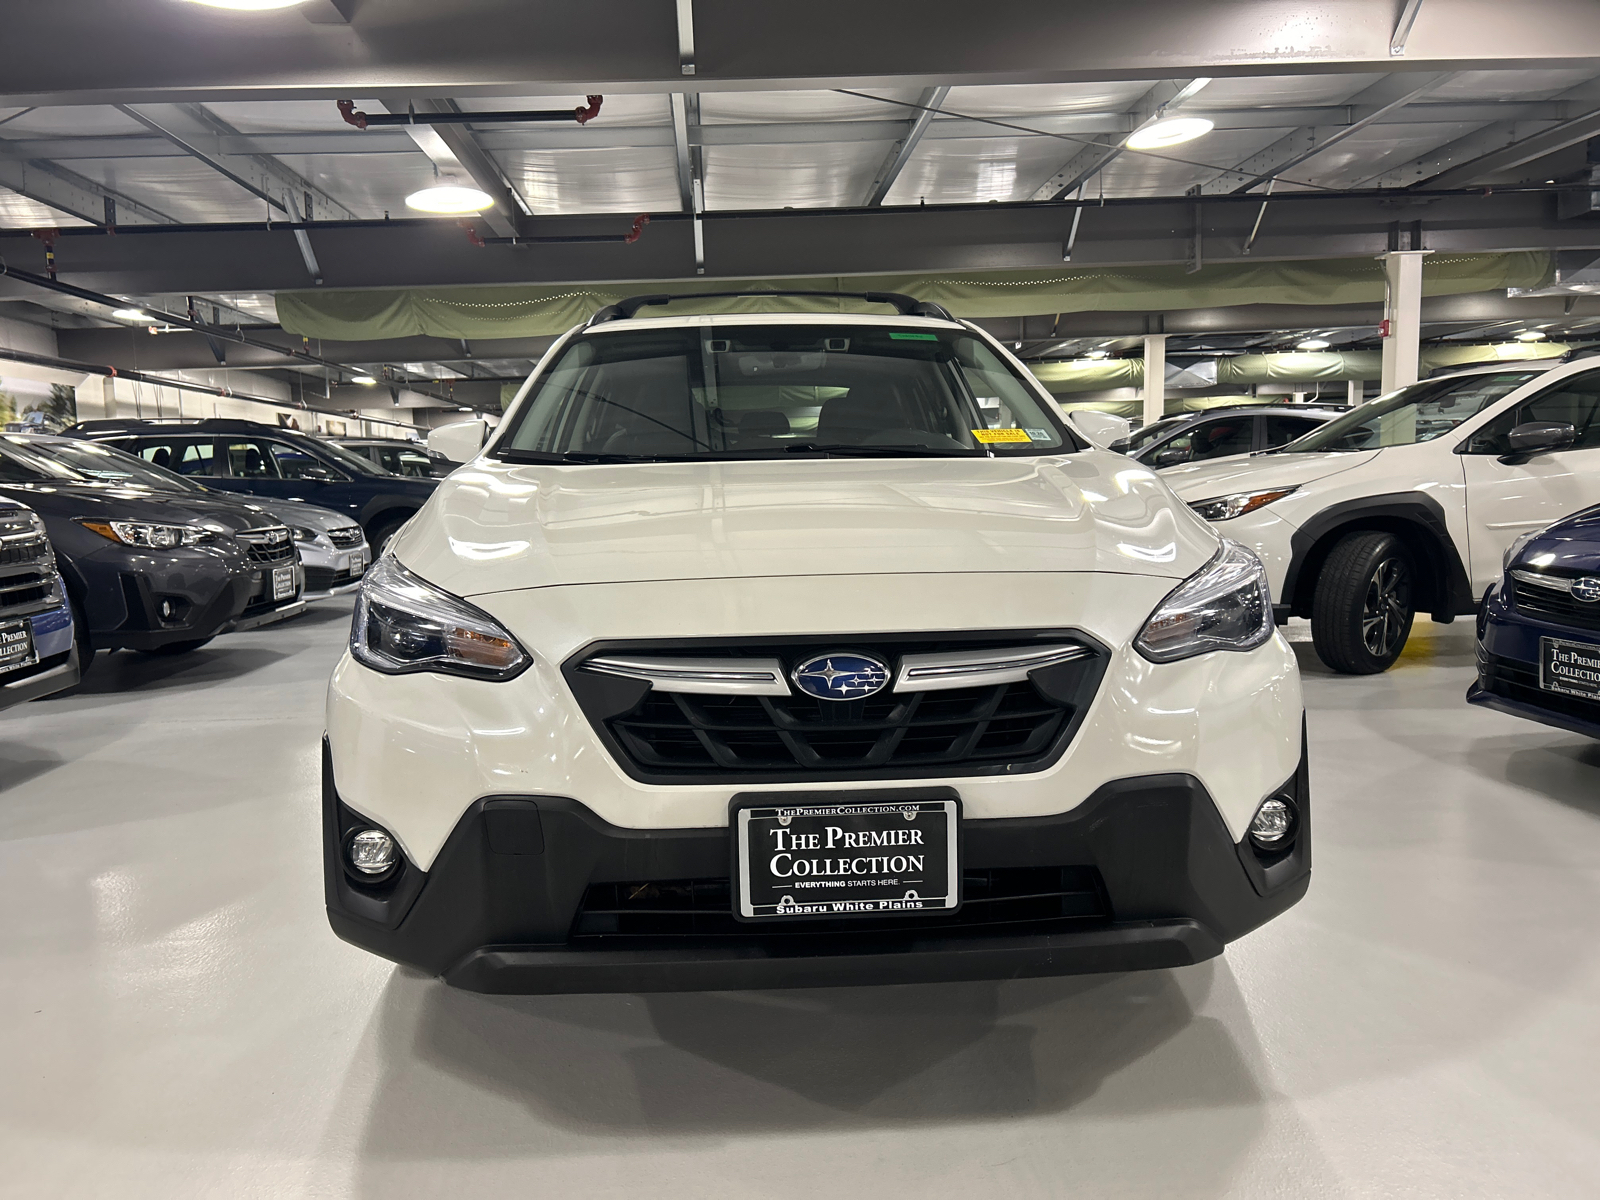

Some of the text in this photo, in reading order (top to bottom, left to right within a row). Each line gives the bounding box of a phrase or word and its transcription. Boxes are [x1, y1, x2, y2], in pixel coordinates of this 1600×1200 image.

[1, 630, 27, 643] PREMIER
[1551, 648, 1570, 663] THE
[1551, 661, 1600, 682] COLLECTIO
[769, 826, 925, 851] THE PREMIER
[769, 853, 925, 878] COLLECTION
[794, 880, 846, 889] EVERYTHING
[847, 879, 877, 888] STARTS
[776, 899, 924, 915] Subaru White Plains
